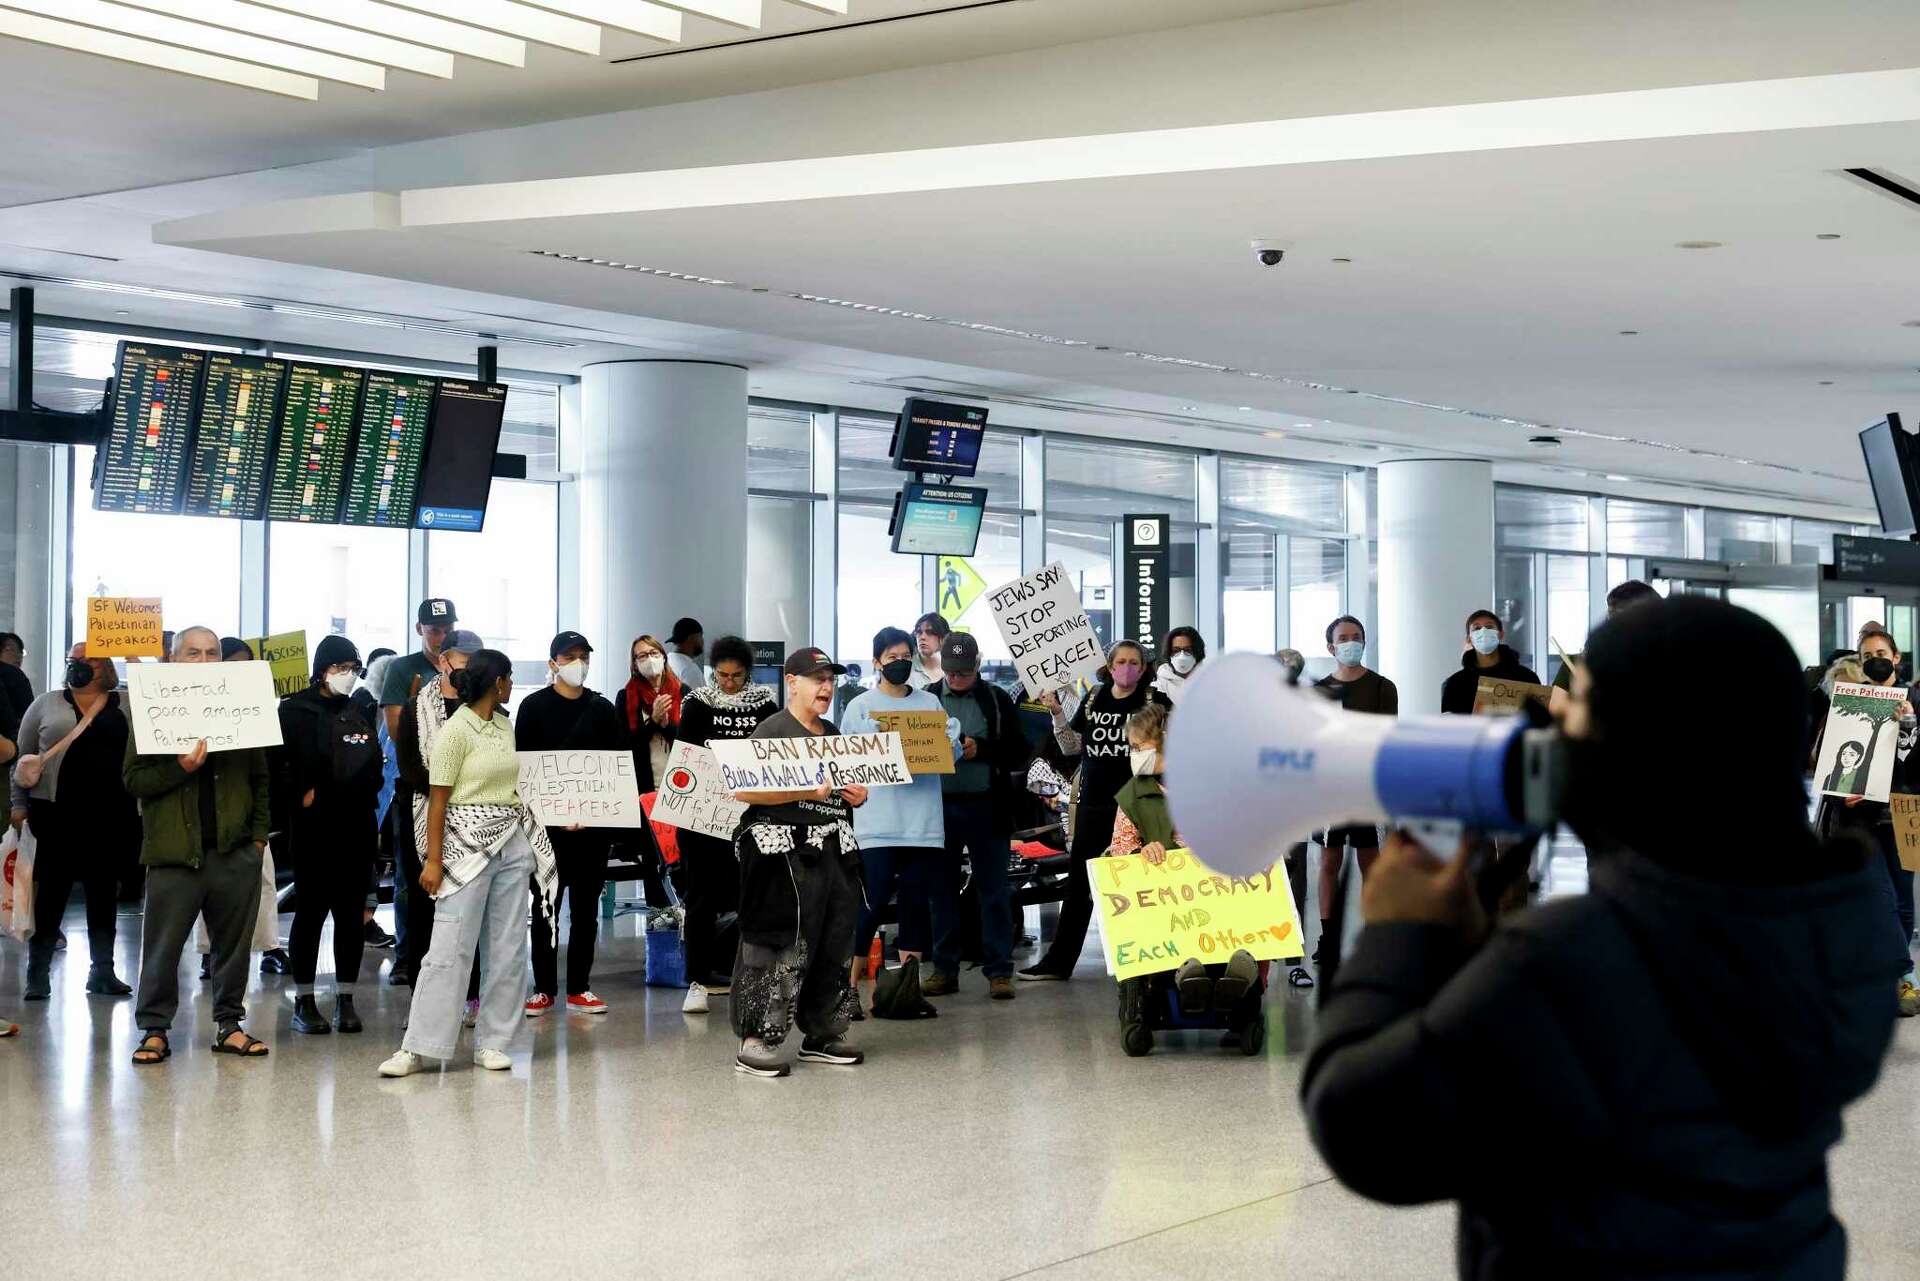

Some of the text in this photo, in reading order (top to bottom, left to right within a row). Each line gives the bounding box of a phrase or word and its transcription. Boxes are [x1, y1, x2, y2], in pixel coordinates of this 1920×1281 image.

[94, 600, 162, 614] SF Welcomes
[990, 581, 1035, 612] JEWS
[1139, 559, 1155, 649] Informati
[89, 617, 156, 631] Palestinian
[1006, 601, 1055, 635] STOP
[1009, 614, 1087, 659] DEPORTING
[1026, 638, 1096, 685] PEACE!
[138, 674, 230, 700] Libertad
[1834, 685, 1905, 700] Free Palestine
[147, 703, 261, 726] para amigos
[713, 716, 757, 728] NO $$$
[876, 715, 900, 732] SF
[153, 728, 240, 747] Palestnos!
[750, 734, 890, 761] BAN RACISM!
[1086, 744, 1130, 757] NAM
[520, 753, 632, 779] WELCOME
[768, 764, 814, 787] WALL
[662, 790, 694, 815] NOT
[1103, 864, 1274, 917] DEMOCRACY
[1170, 908, 1212, 932] AND
[1117, 928, 1270, 966] EACH Other
